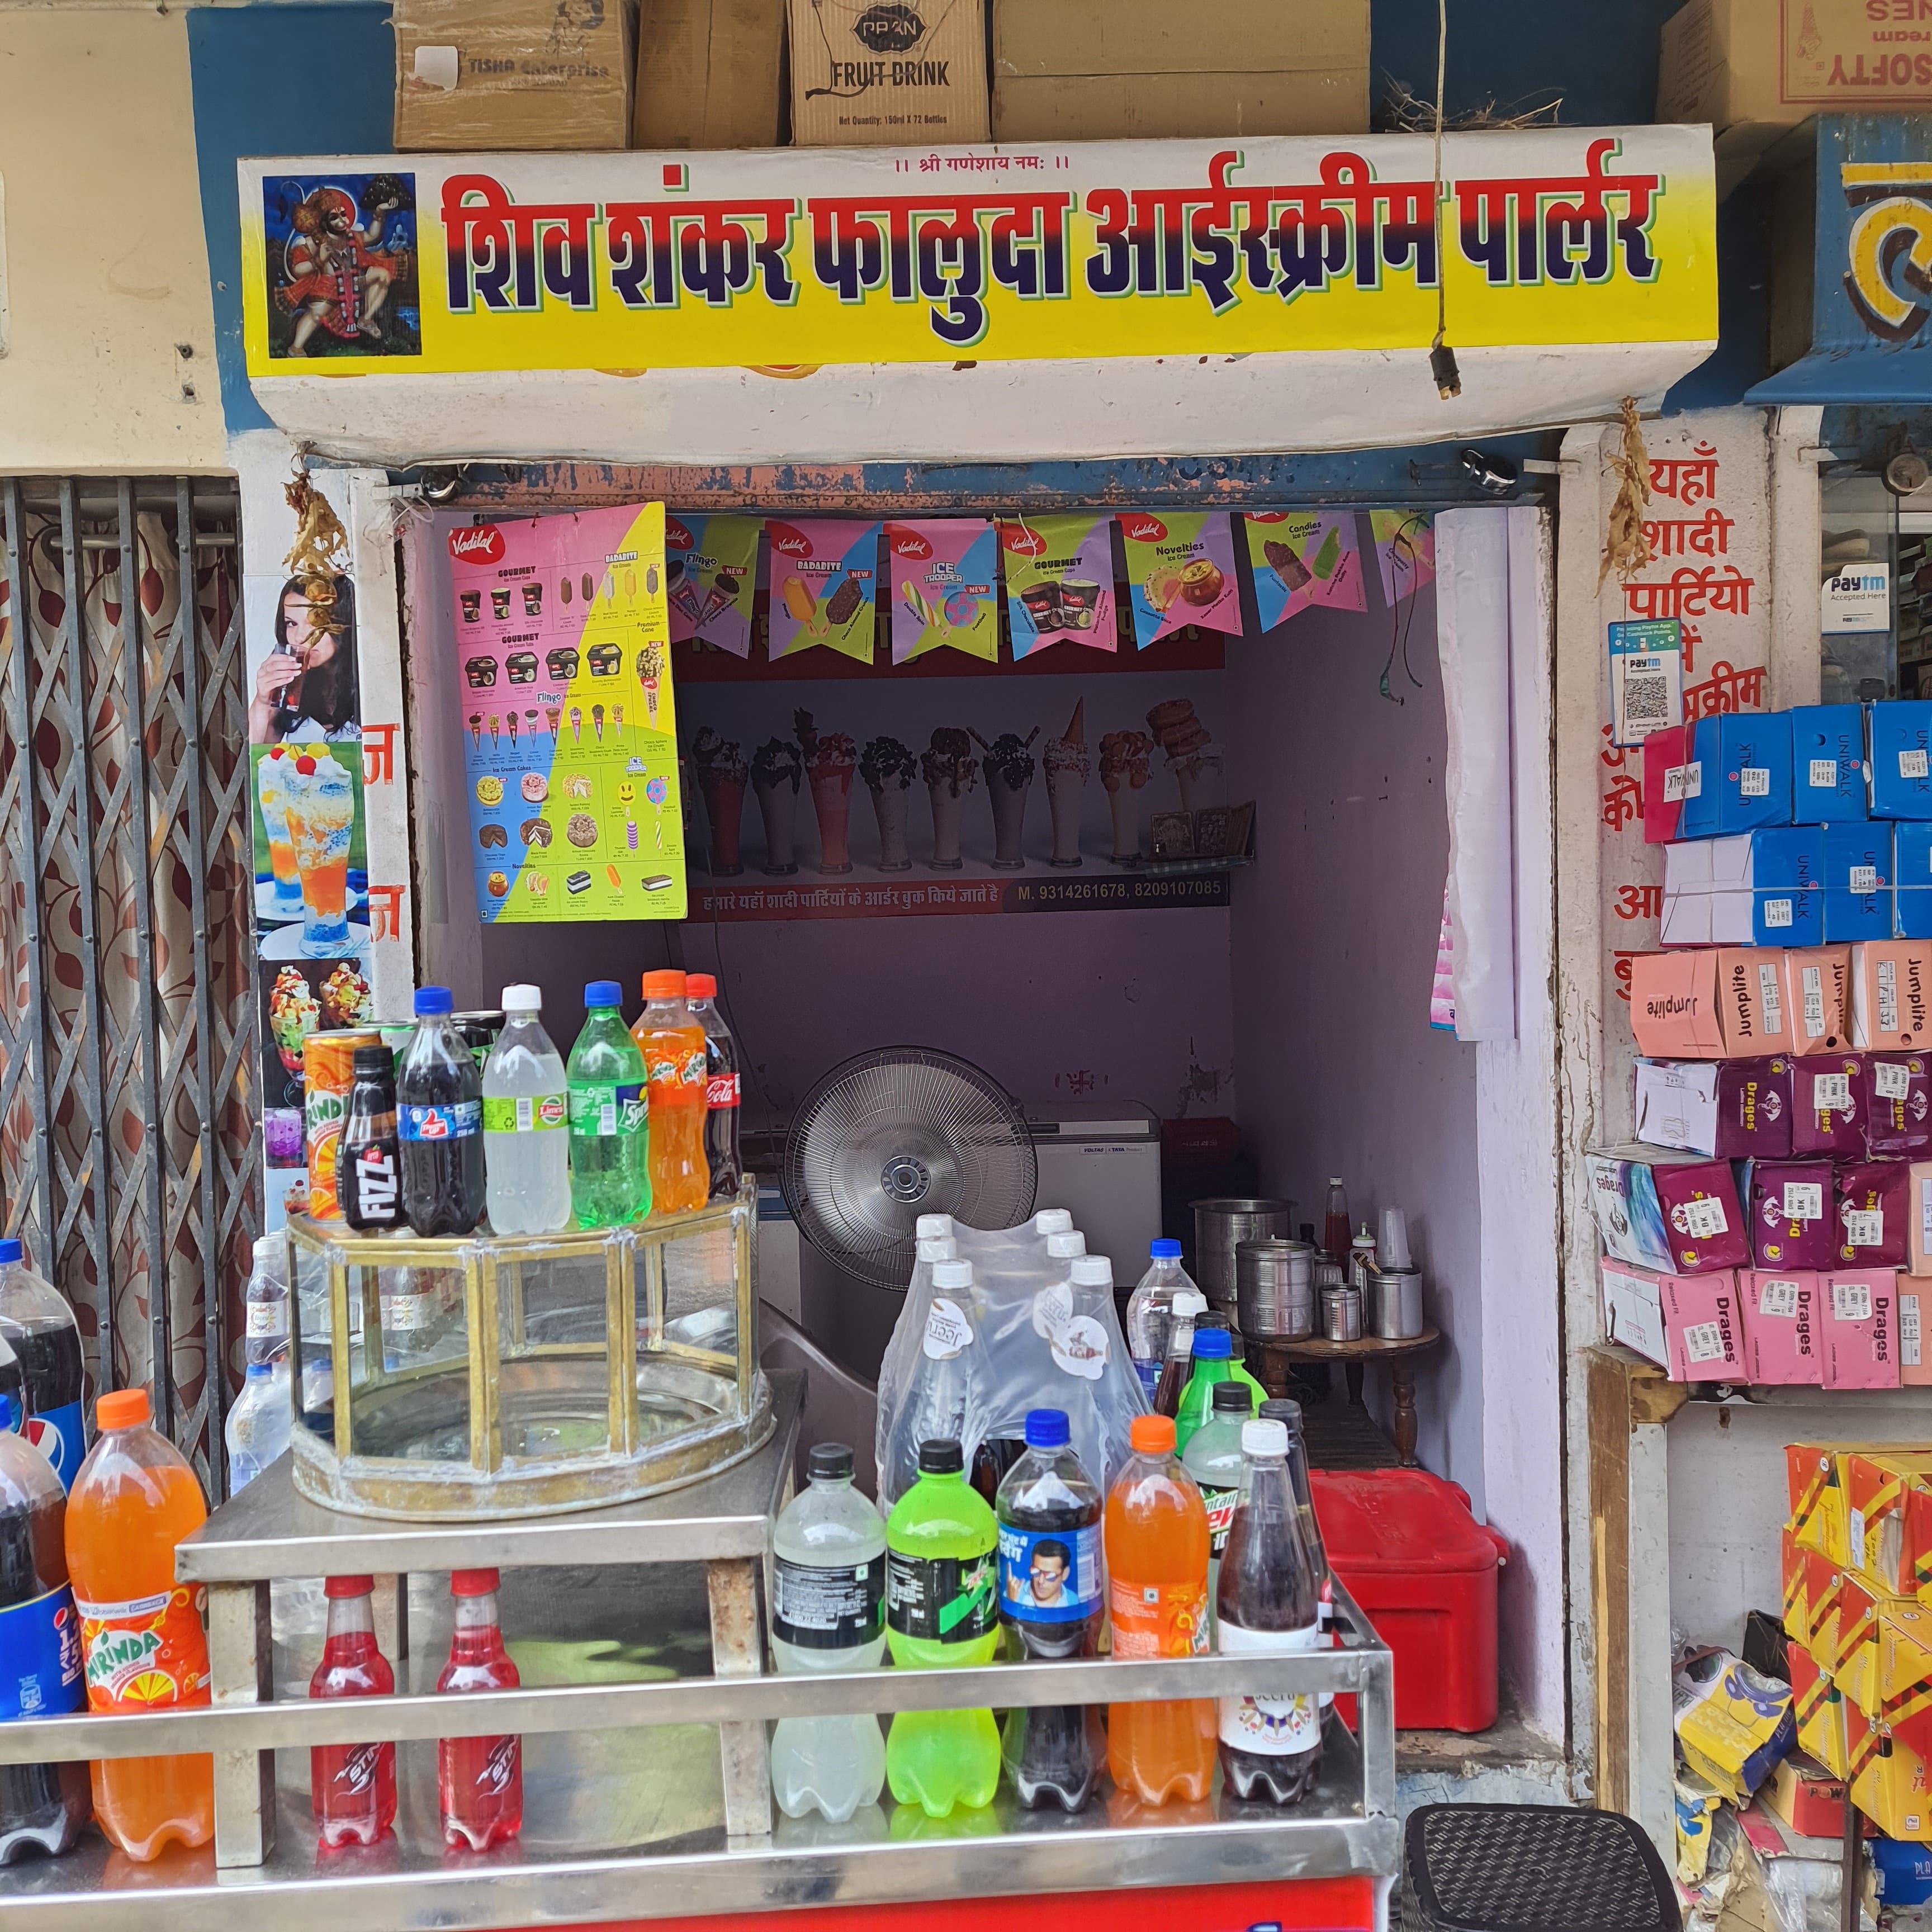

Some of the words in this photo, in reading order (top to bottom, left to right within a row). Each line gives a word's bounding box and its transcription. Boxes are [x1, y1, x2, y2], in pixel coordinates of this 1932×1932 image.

[832, 61, 886, 87] FRUIT
[893, 61, 951, 87] DRINK
[839, 116, 850, 125] Net
[853, 116, 882, 127] Quantity:
[913, 115, 922, 124] 72
[924, 114, 948, 125] Bottles
[920, 154, 942, 172] श्री
[945, 153, 1010, 172] गणेशाय
[1014, 156, 1045, 170] नमः
[441, 174, 602, 314] शिव
[606, 164, 802, 309] शंकर
[1455, 138, 1666, 287] पार्लर
[1649, 441, 1720, 506] यहाँ
[1131, 523, 1159, 538] Vadilal
[1289, 522, 1322, 533] Candies
[779, 538, 807, 553] Vadilal
[898, 541, 926, 555] Vadilal
[1156, 542, 1204, 556] Novelties
[686, 553, 717, 567] Flingo
[932, 562, 954, 574] ICE
[1034, 558, 1083, 570] GOURMET
[924, 573, 963, 584] TROOPER
[969, 585, 987, 594] NEW
[1830, 592, 1865, 602] Accepted
[1867, 591, 1887, 600] Here
[537, 692, 562, 704] Flingo
[1838, 735, 1852, 798] UNIWALK
[767, 890, 798, 908] शादी
[848, 888, 861, 906] के
[902, 890, 925, 910] बुक
[927, 885, 956, 903] किये
[959, 884, 987, 903] जाते
[1018, 886, 1034, 901] M.
[1039, 883, 1130, 900] 9314261678,
[1135, 880, 1221, 897] 8209107085
[1797, 855, 1810, 920] UNIWALK
[1732, 964, 1752, 1037] Jumplite
[1907, 958, 1926, 1032] Jumplite
[1647, 995, 1697, 1020] Jumplite
[1745, 1082, 1758, 1130] Drages
[356, 1155, 397, 1220] FIZZ
[1596, 1175, 1626, 1197] Drages
[1716, 1297, 1735, 1362] Drages
[1796, 1291, 1811, 1355] Drages
[1873, 1297, 1889, 1361] Drages
[86, 1632, 160, 1685] MIRINDA
